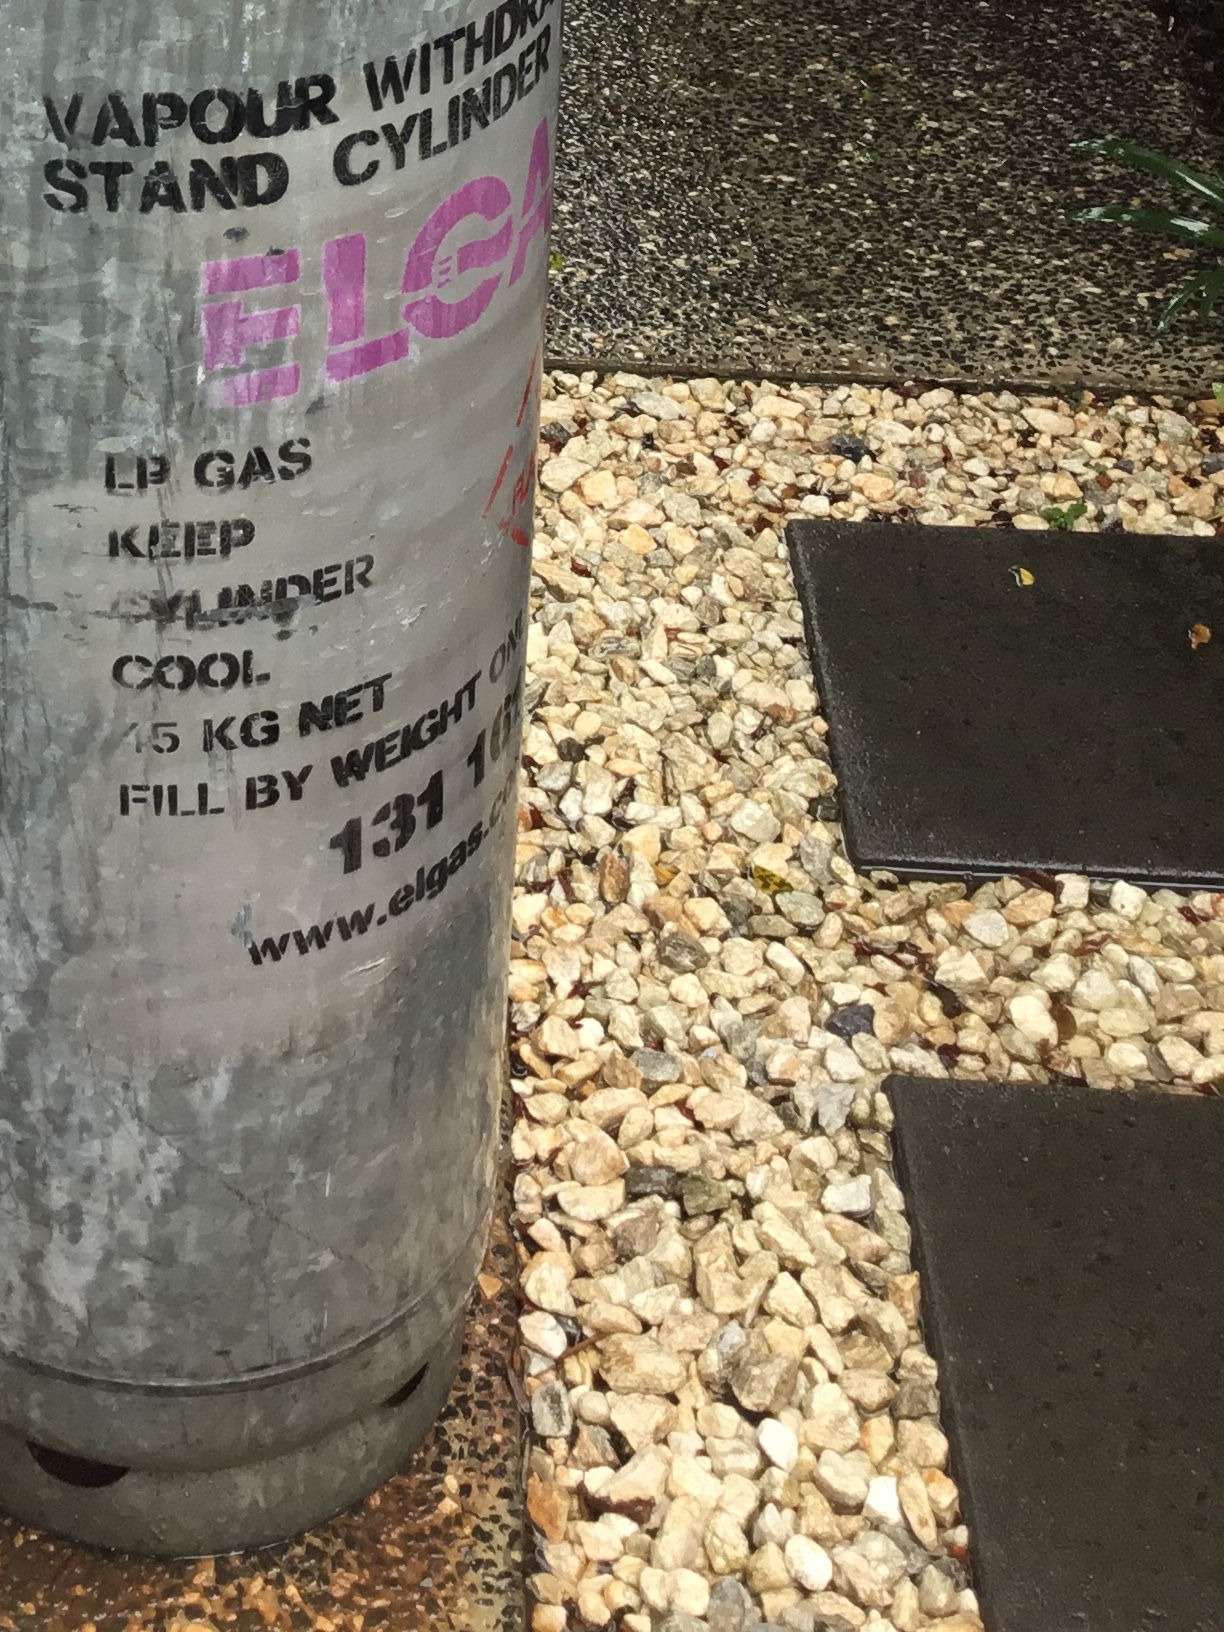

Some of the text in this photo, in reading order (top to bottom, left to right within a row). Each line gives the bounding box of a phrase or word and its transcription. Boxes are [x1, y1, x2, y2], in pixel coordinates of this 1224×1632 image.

[43, 74, 340, 148] VAPOUR
[43, 23, 551, 214] STAND CYLINDER
[104, 438, 313, 491] LP GAS
[108, 518, 256, 559] KEEP
[112, 649, 270, 690] COOL
[119, 608, 523, 817] FILL BY WEIGHT ON
[202, 710, 279, 754] KG
[298, 673, 393, 738] NET
[328, 769, 445, 876] 131
